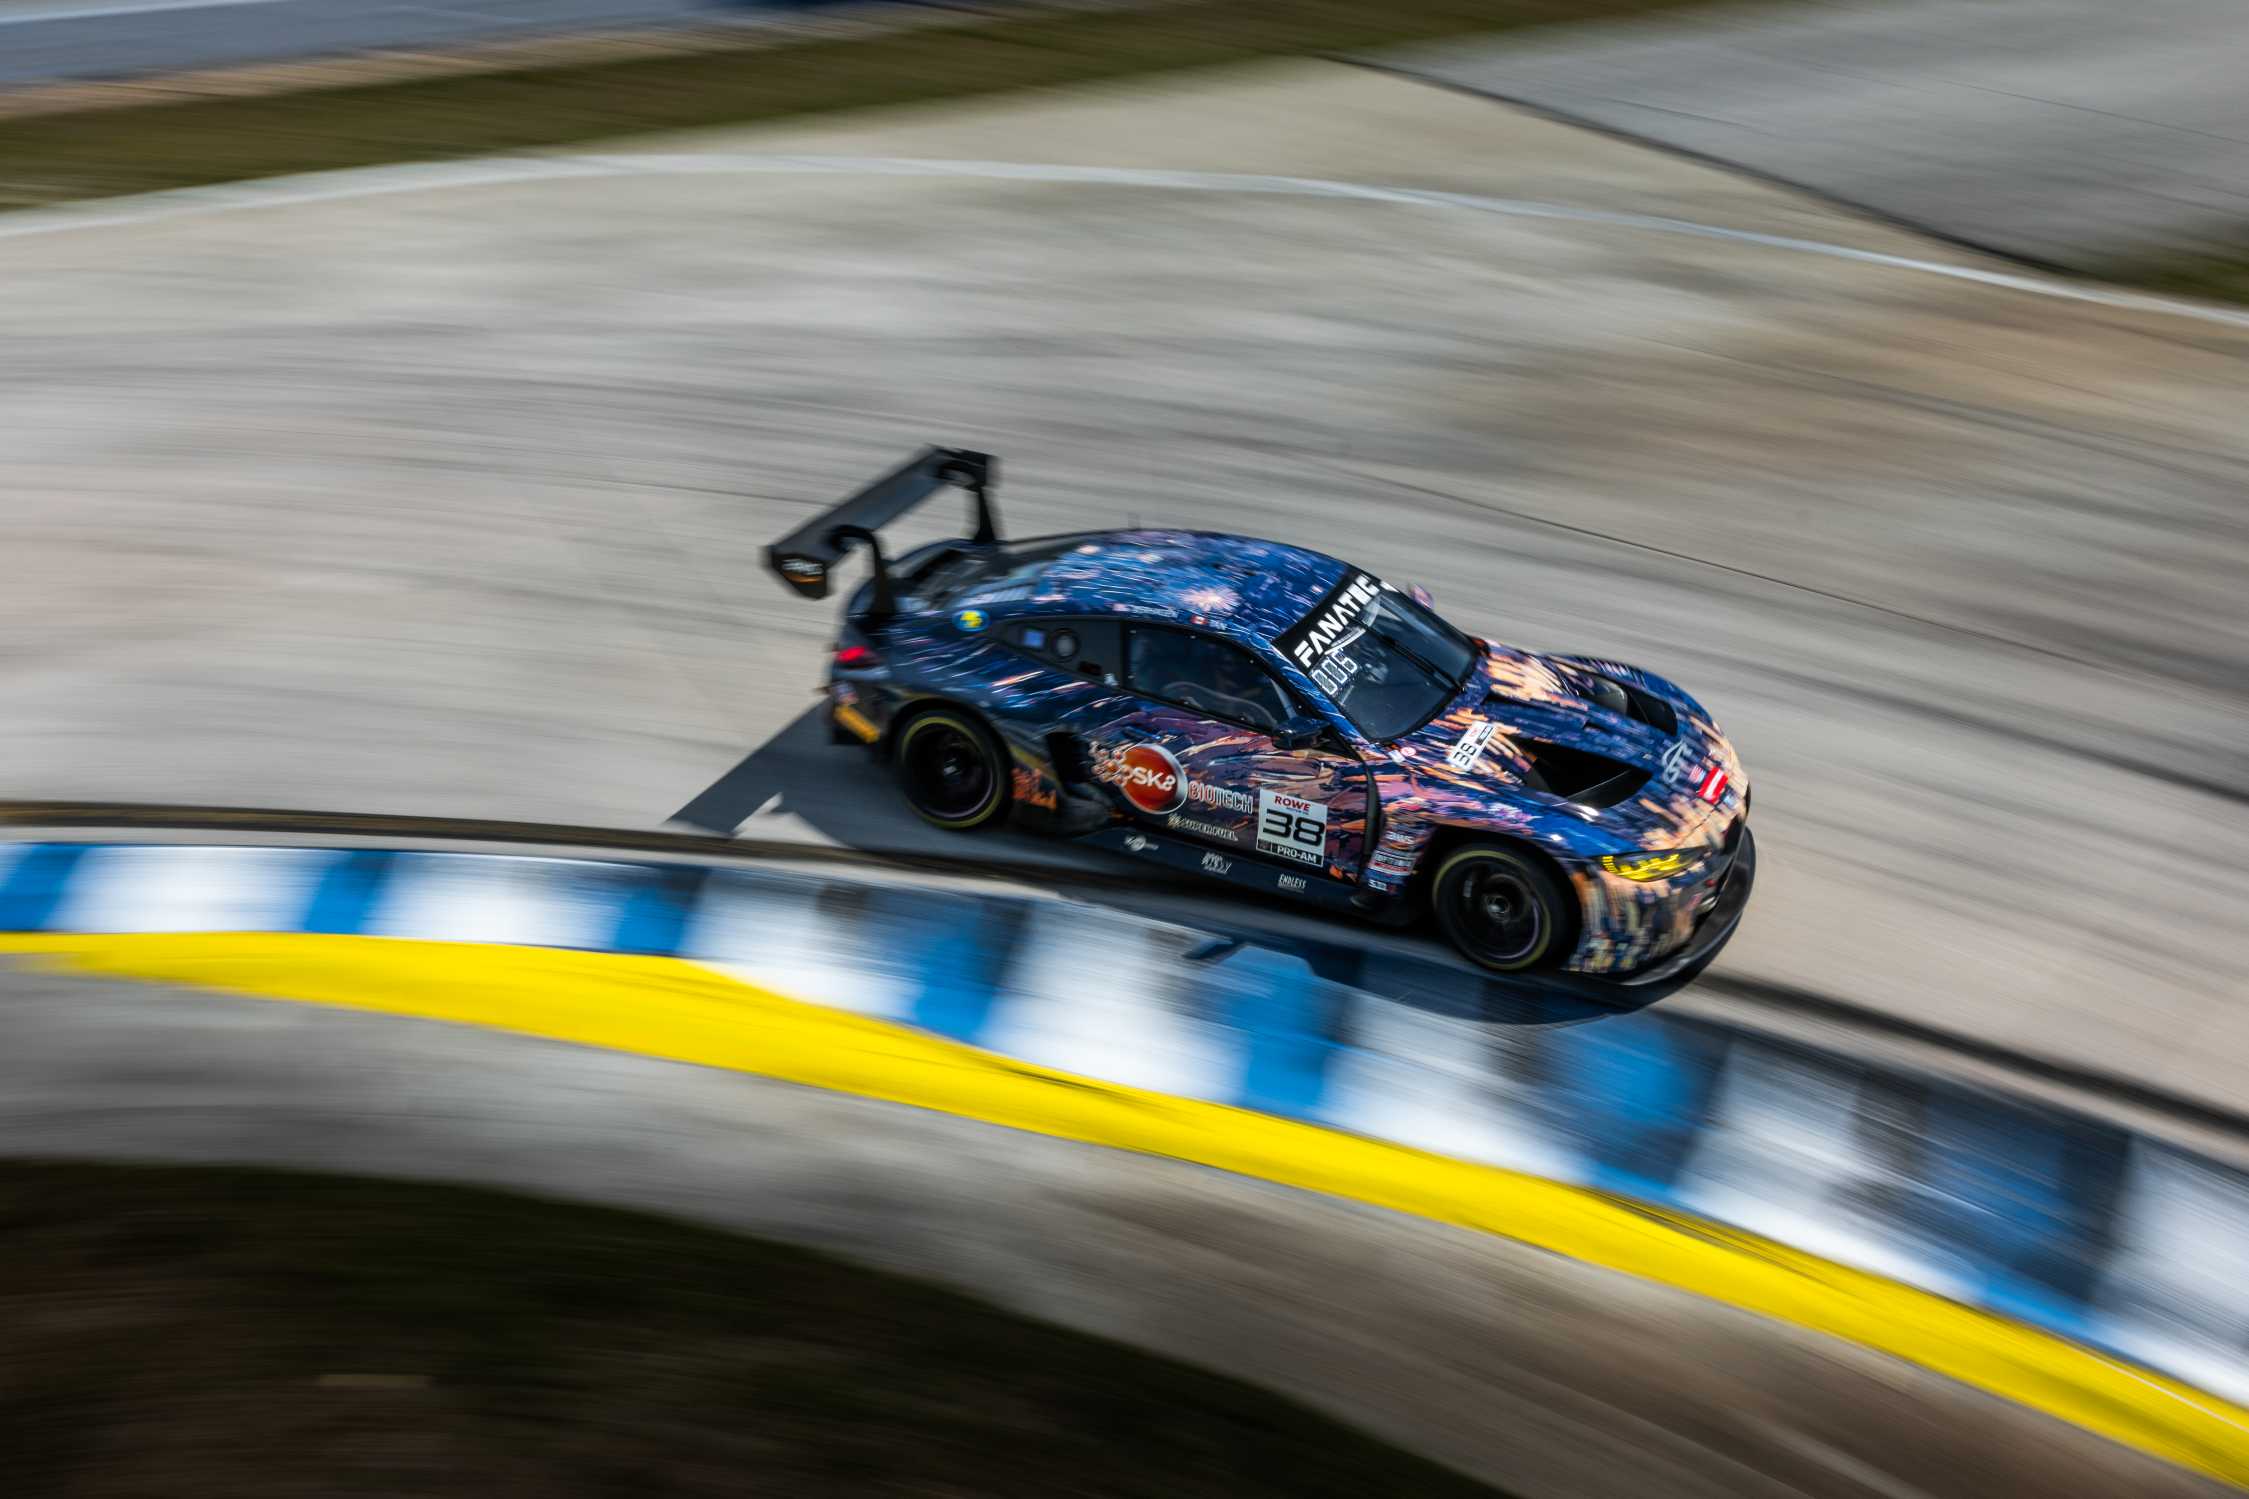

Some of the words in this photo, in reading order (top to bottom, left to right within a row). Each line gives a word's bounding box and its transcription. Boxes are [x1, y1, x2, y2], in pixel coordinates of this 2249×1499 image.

[1453, 742, 1477, 766] 38
[1188, 780, 1254, 815] BIOTECH
[1274, 795, 1312, 812] ROWE
[1262, 808, 1326, 847] 38
[1277, 845, 1318, 864] PRO-AM
